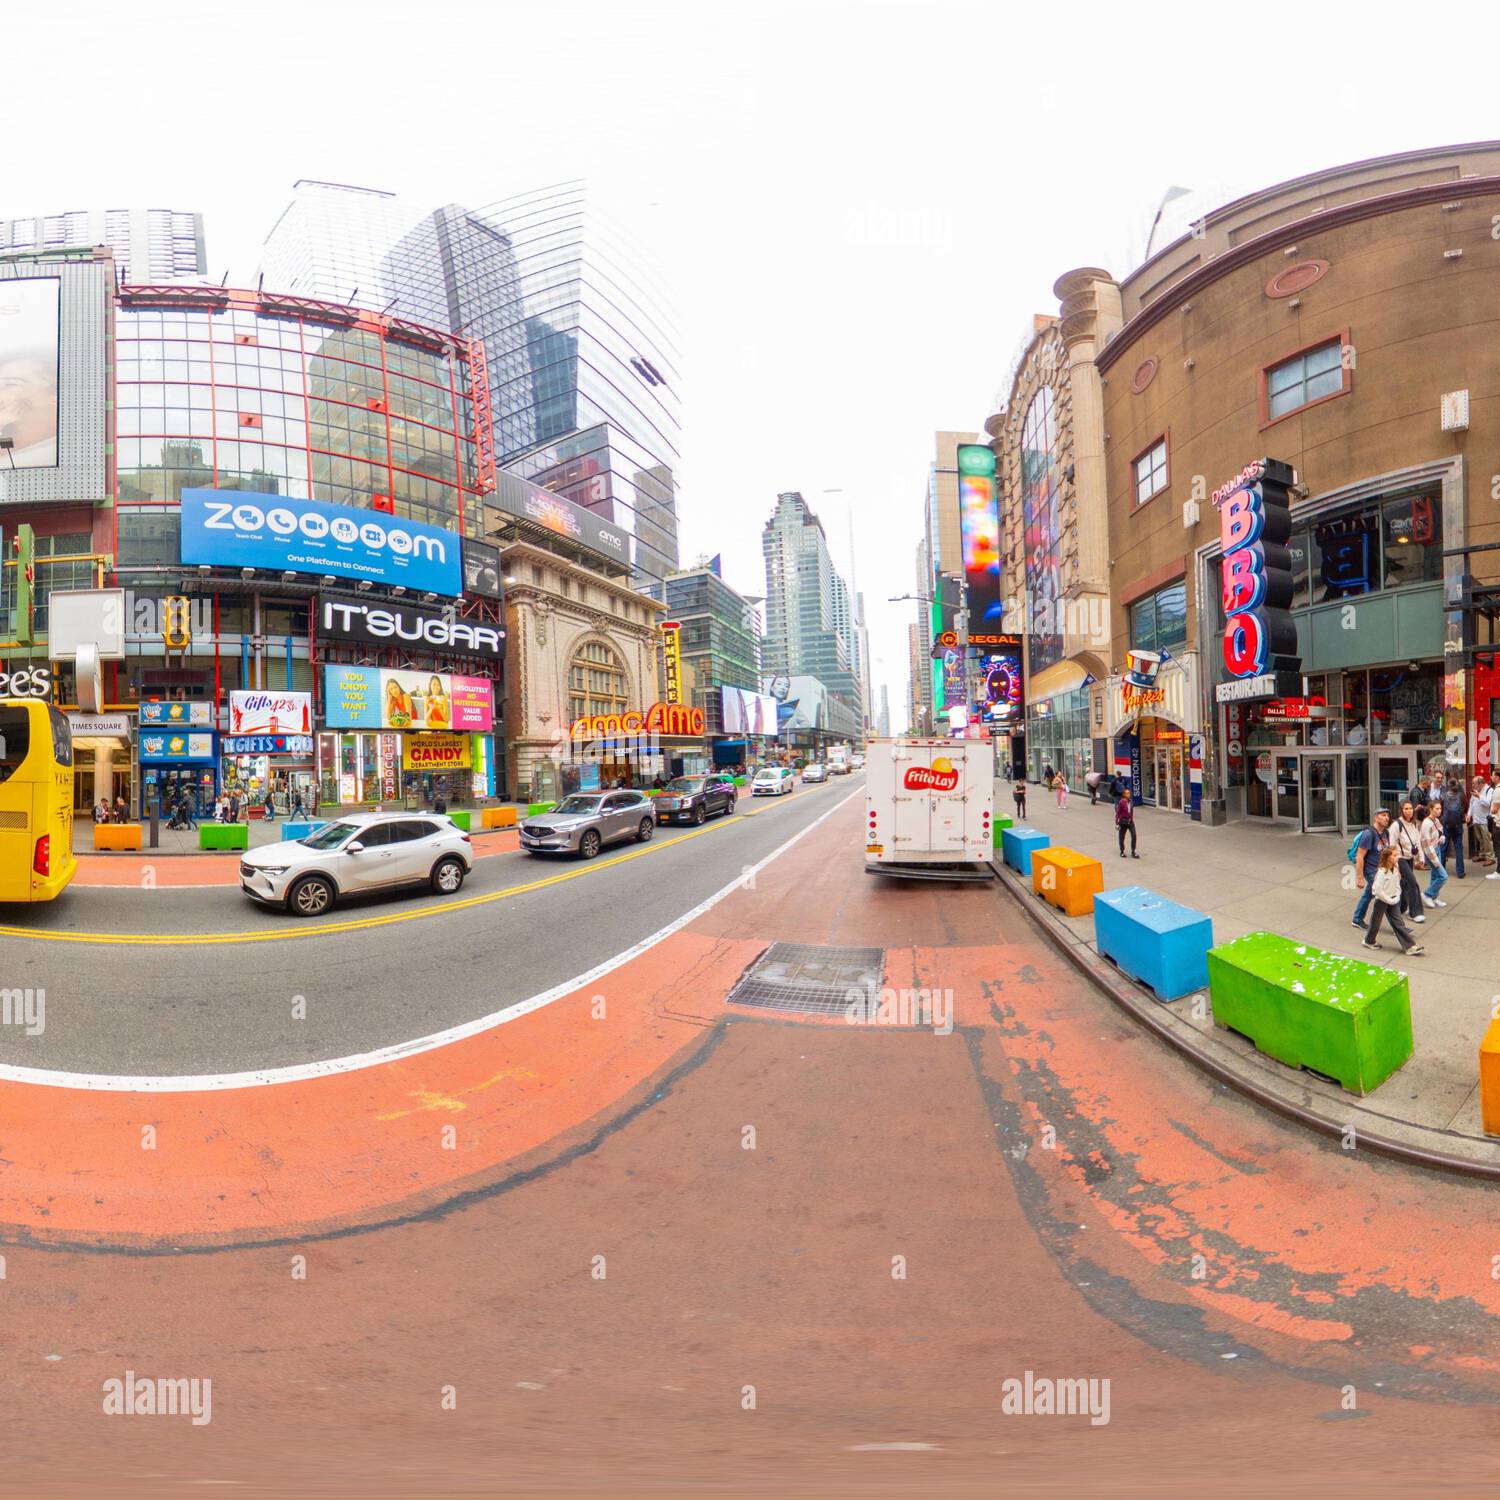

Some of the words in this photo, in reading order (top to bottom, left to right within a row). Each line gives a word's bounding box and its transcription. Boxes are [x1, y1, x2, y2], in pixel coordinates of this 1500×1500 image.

[1211, 459, 1262, 505] DALLAS
[287, 554, 305, 563] One
[306, 556, 341, 568] Platform
[352, 563, 385, 575] Connect
[1219, 488, 1264, 678] BBQ
[323, 601, 500, 652] IT'SUGAR
[967, 634, 1019, 644] REGAL
[665, 633, 680, 702] EMPIRE
[344, 672, 364, 682] YOU
[345, 692, 364, 700] YOU
[1216, 673, 1277, 702] RESTAURANT
[244, 695, 273, 711] Gifts
[341, 702, 368, 711] WANT
[94, 723, 122, 731] SQUARE
[1228, 703, 1243, 757] BBQ
[235, 735, 275, 753] GIFTS
[1131, 747, 1141, 758] 42
[410, 748, 464, 761] CANDY
[1132, 761, 1142, 797] SECTION
